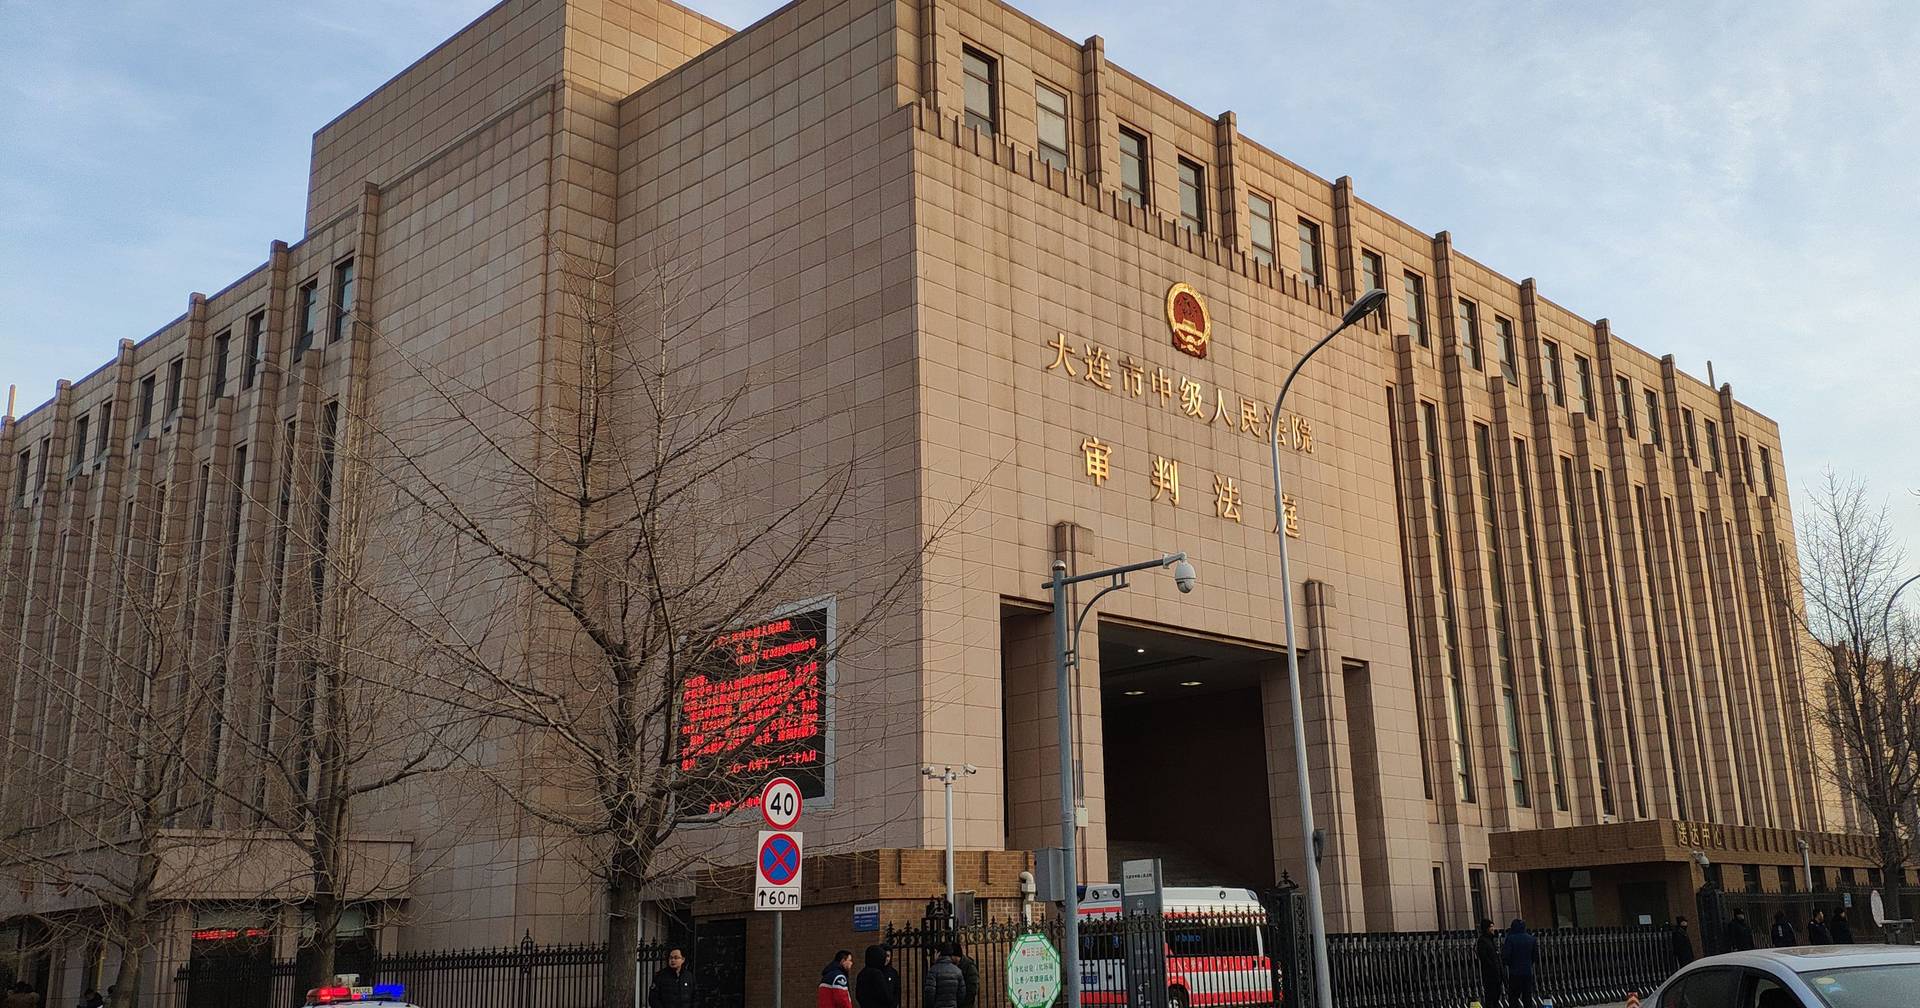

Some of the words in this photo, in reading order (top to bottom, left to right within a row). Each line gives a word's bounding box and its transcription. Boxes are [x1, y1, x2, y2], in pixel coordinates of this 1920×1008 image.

[1047, 332, 1315, 454] 大连市中级人民法院
[1080, 436, 1301, 539] 审判法庭
[727, 749, 817, 773] 〇一八年十一月二十九日
[770, 792, 794, 816] 40
[1677, 822, 1722, 848] 送达中心
[769, 890, 798, 905] 60m
